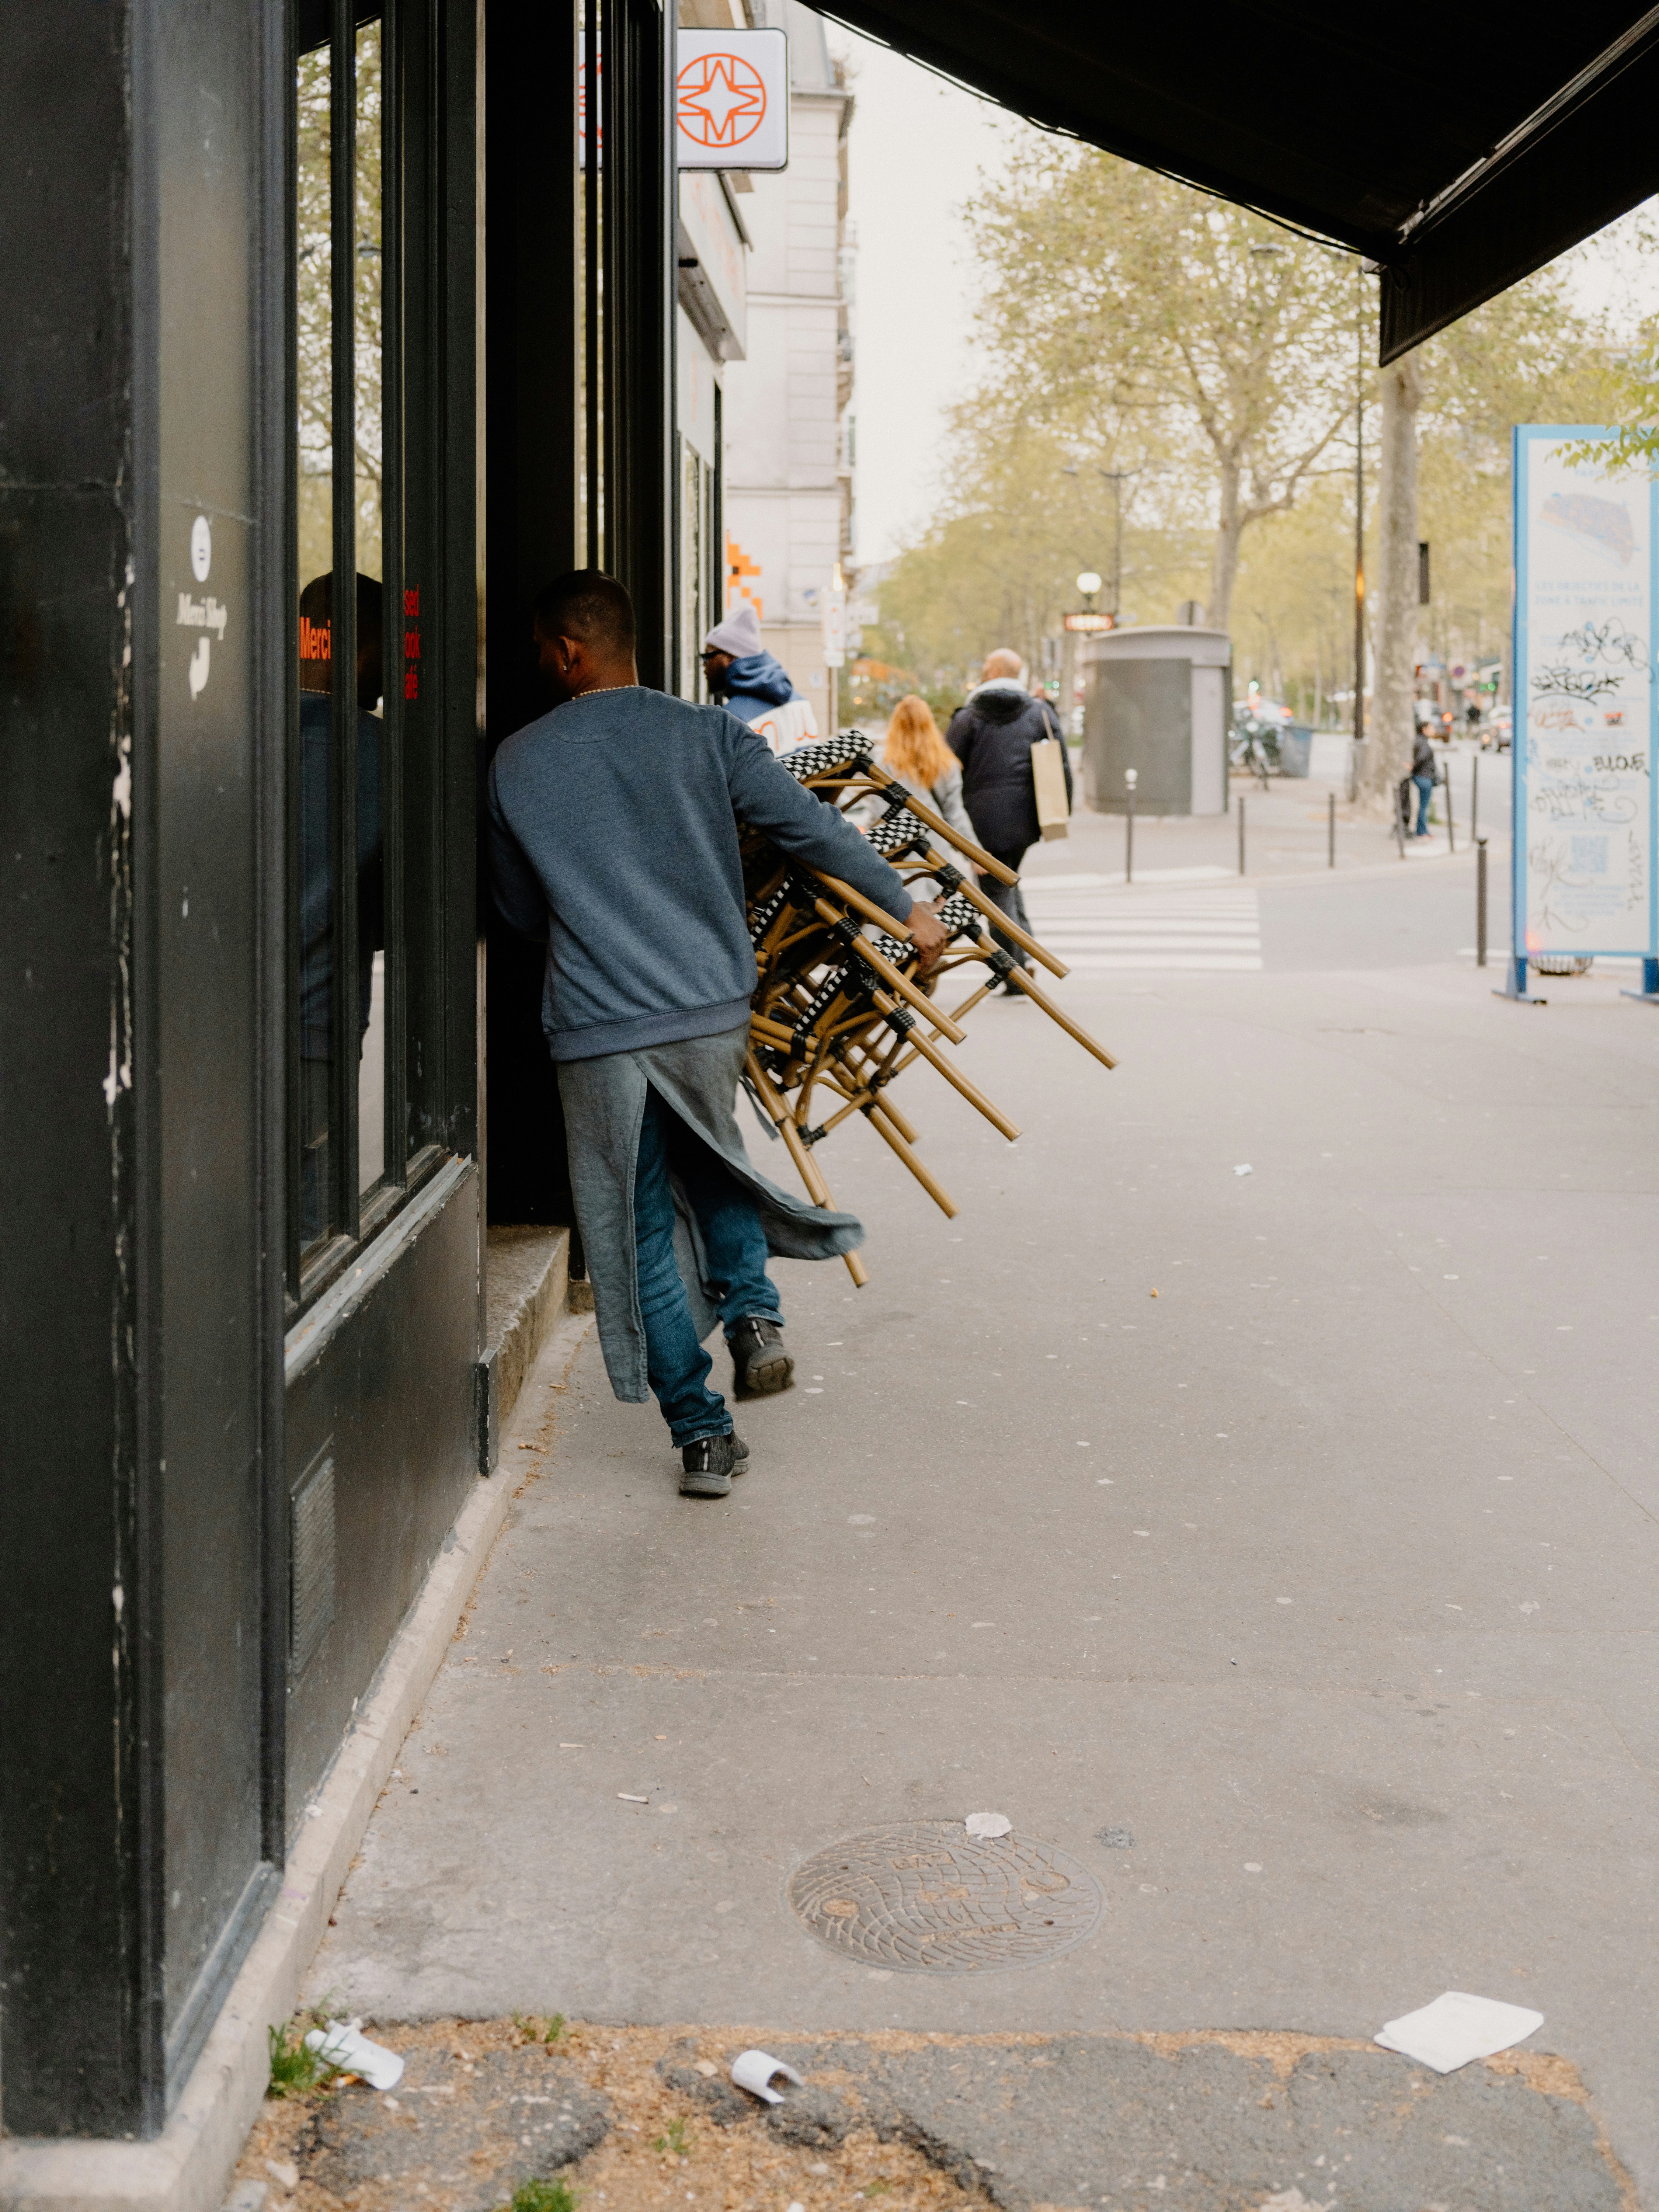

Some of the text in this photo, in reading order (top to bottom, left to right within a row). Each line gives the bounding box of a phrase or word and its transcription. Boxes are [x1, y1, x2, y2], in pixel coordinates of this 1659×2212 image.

[405, 584, 419, 616] sed
[300, 616, 331, 660] Merci
[405, 625, 420, 658] ook
[405, 664, 418, 699] afé
